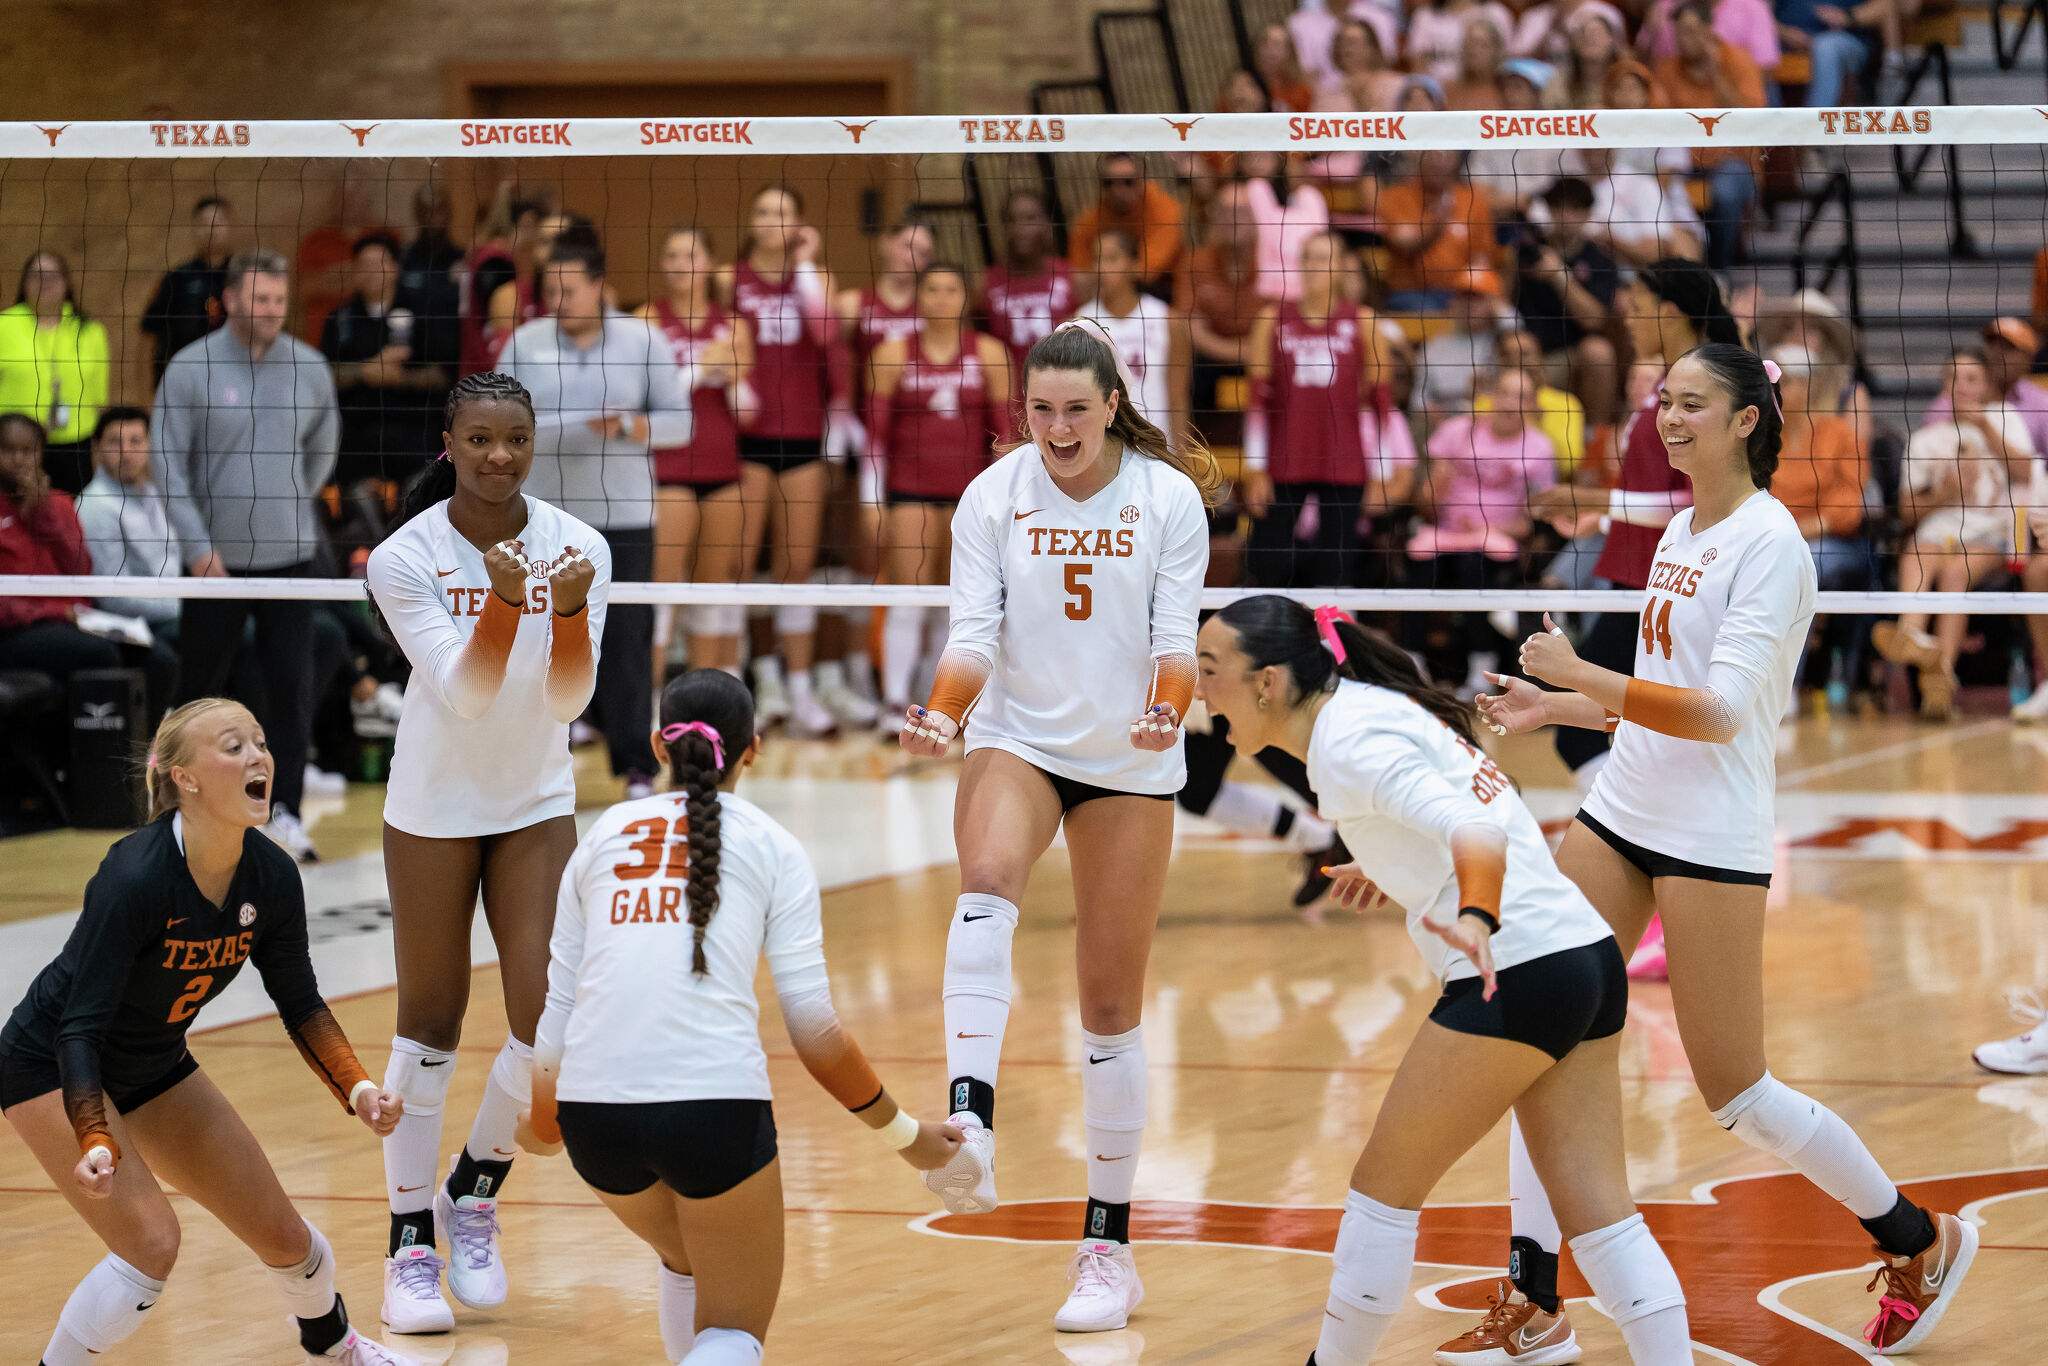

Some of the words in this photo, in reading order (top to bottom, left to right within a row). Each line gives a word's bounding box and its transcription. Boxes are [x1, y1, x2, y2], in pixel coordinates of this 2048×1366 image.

[150, 123, 251, 147] TEXAS
[460, 122, 572, 147] SEATGEEK
[639, 121, 753, 145] SEATGEEK
[959, 118, 1065, 143] TEXAS
[1289, 116, 1407, 141] SEATGEEK
[1480, 113, 1600, 139] SEATGEEK
[1819, 109, 1931, 135] TEXAS
[1120, 505, 1140, 523] SEC
[1028, 528, 1134, 557] TEXAS
[1064, 563, 1092, 621] 5
[1648, 561, 1704, 598] TEXAS
[447, 585, 548, 617] TES
[1642, 596, 1673, 660] 44
[610, 886, 694, 925] GAR
[162, 931, 253, 970] TEXAS
[167, 975, 214, 1023] 2
[410, 1249, 425, 1258] NIKE
